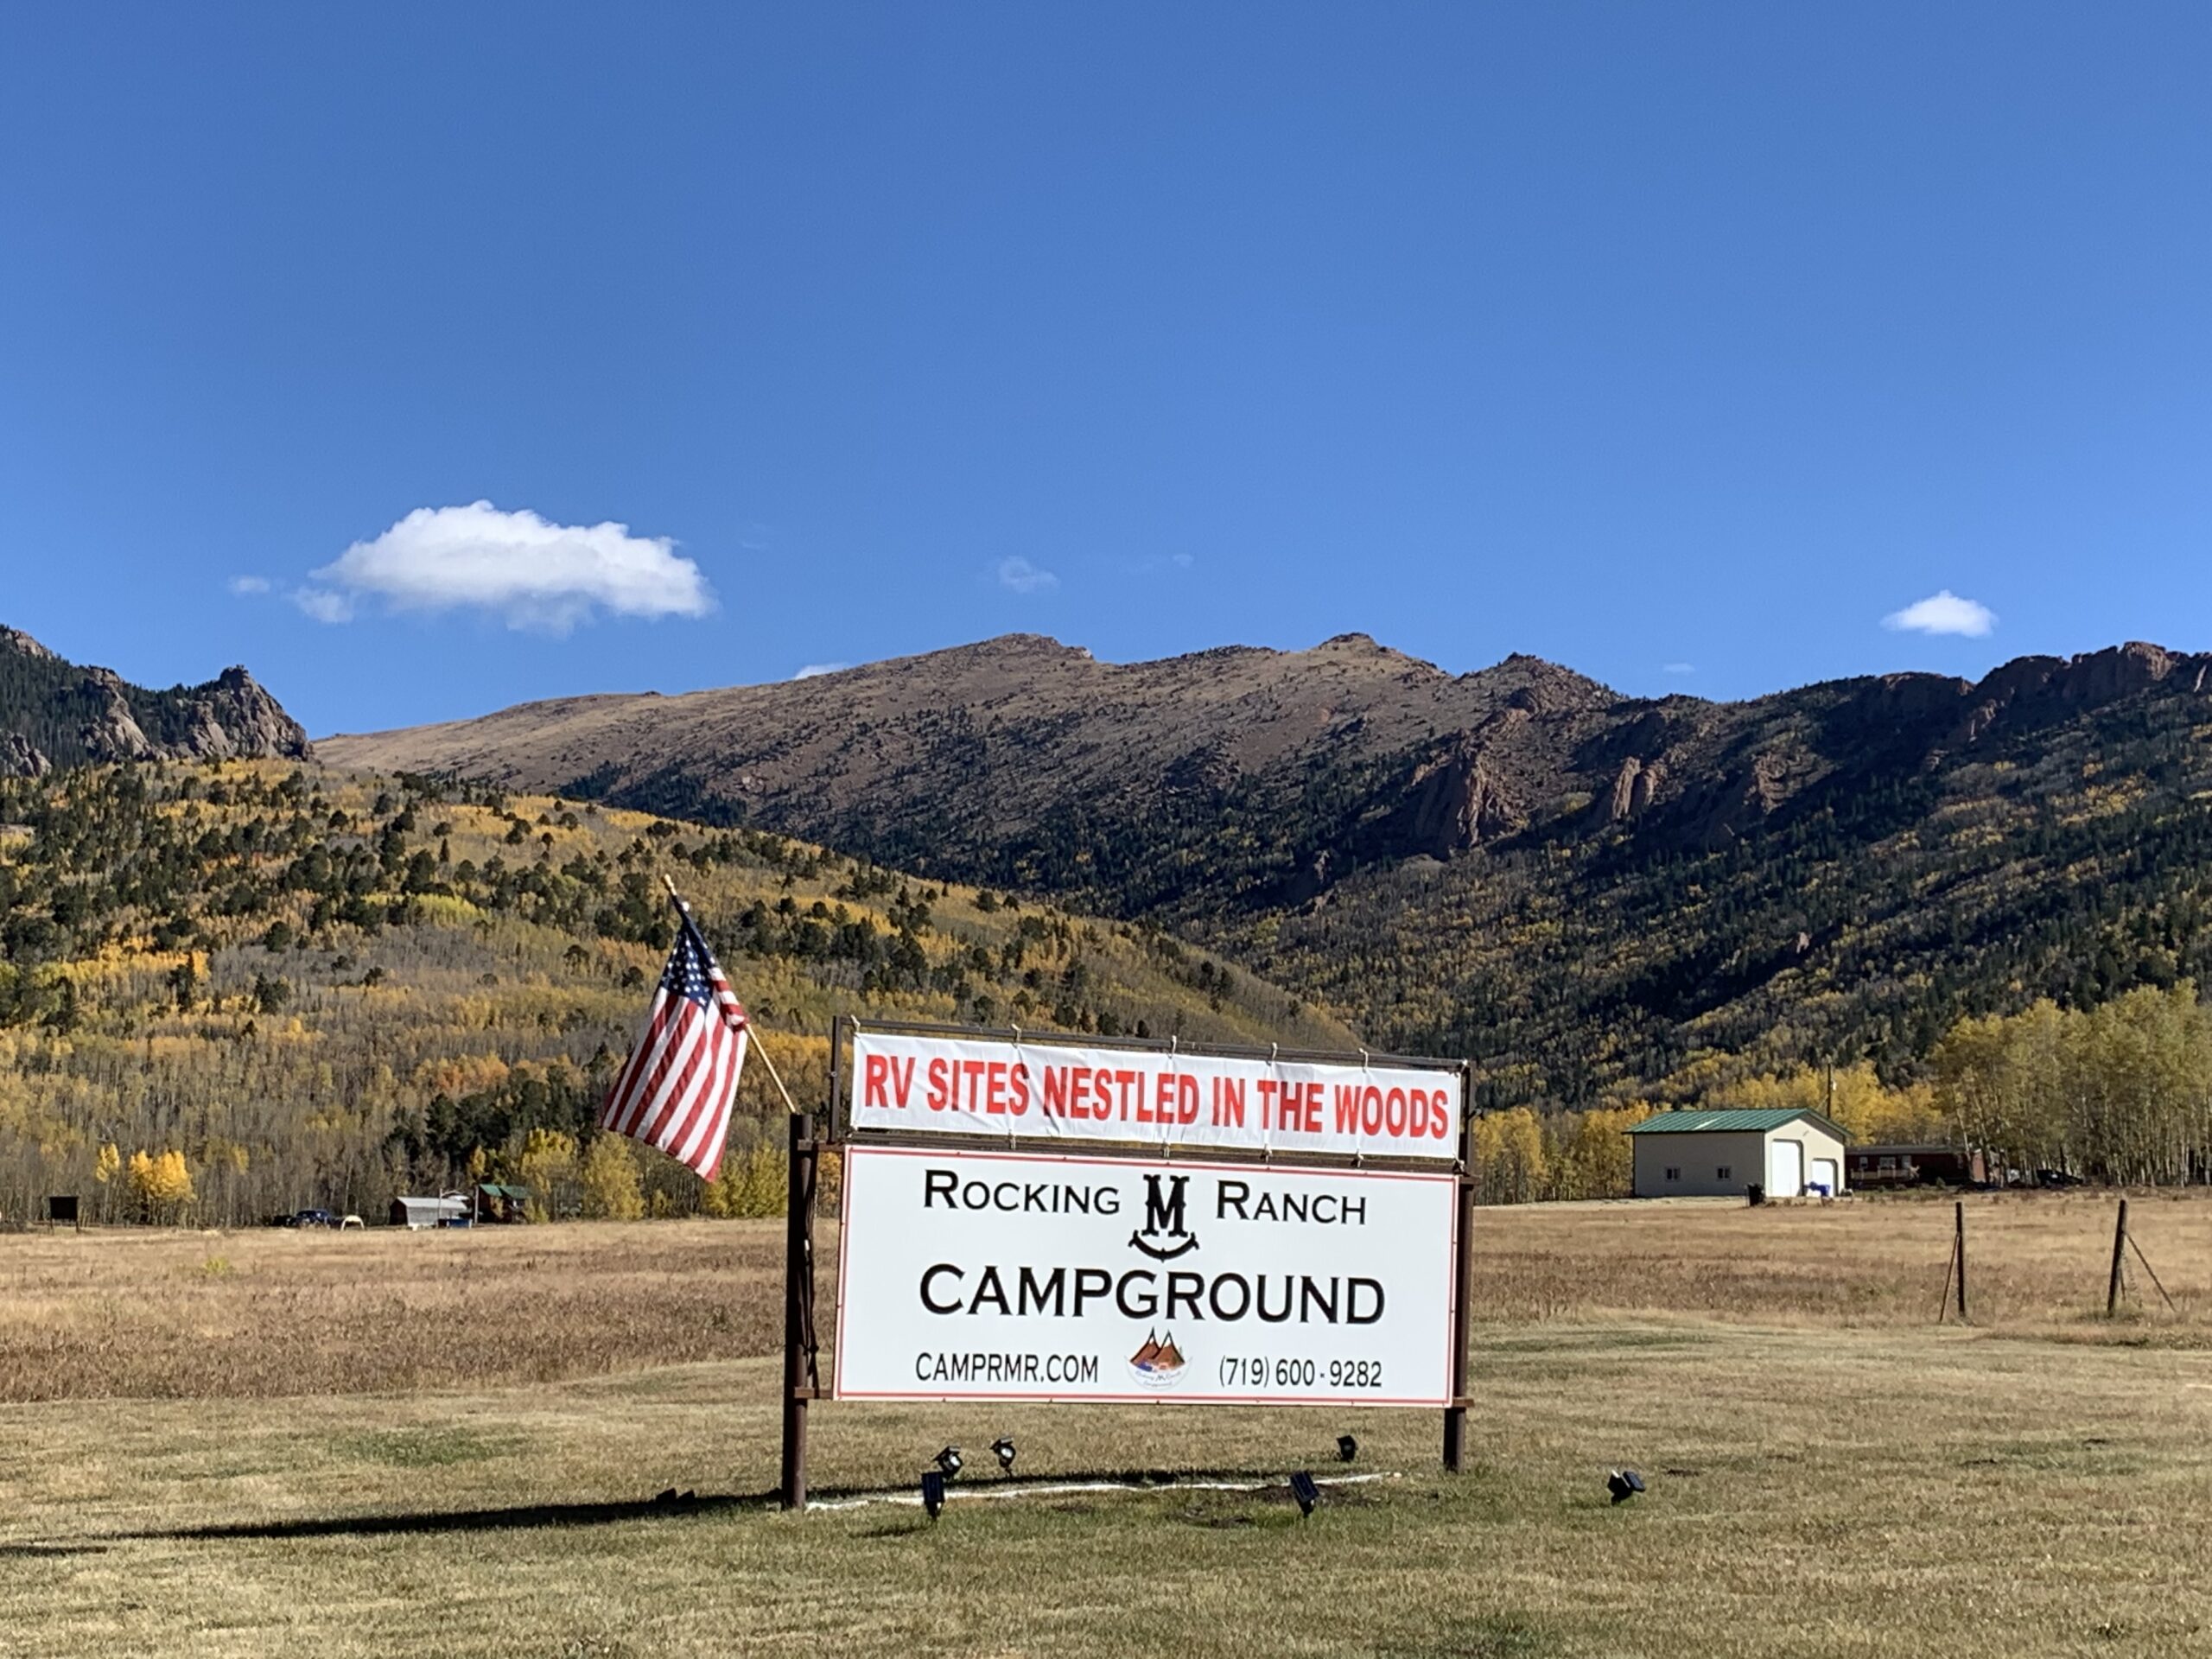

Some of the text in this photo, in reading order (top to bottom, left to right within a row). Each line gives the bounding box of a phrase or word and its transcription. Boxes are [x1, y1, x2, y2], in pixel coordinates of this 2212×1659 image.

[864, 1053, 1449, 1141] RV SITES NESTLED IN THE WOODS
[923, 1168, 1368, 1238] ROCKING M RANCH
[918, 1262, 1386, 1325] CAMPGROUND
[914, 1351, 1099, 1383] CAMPRMR.COM
